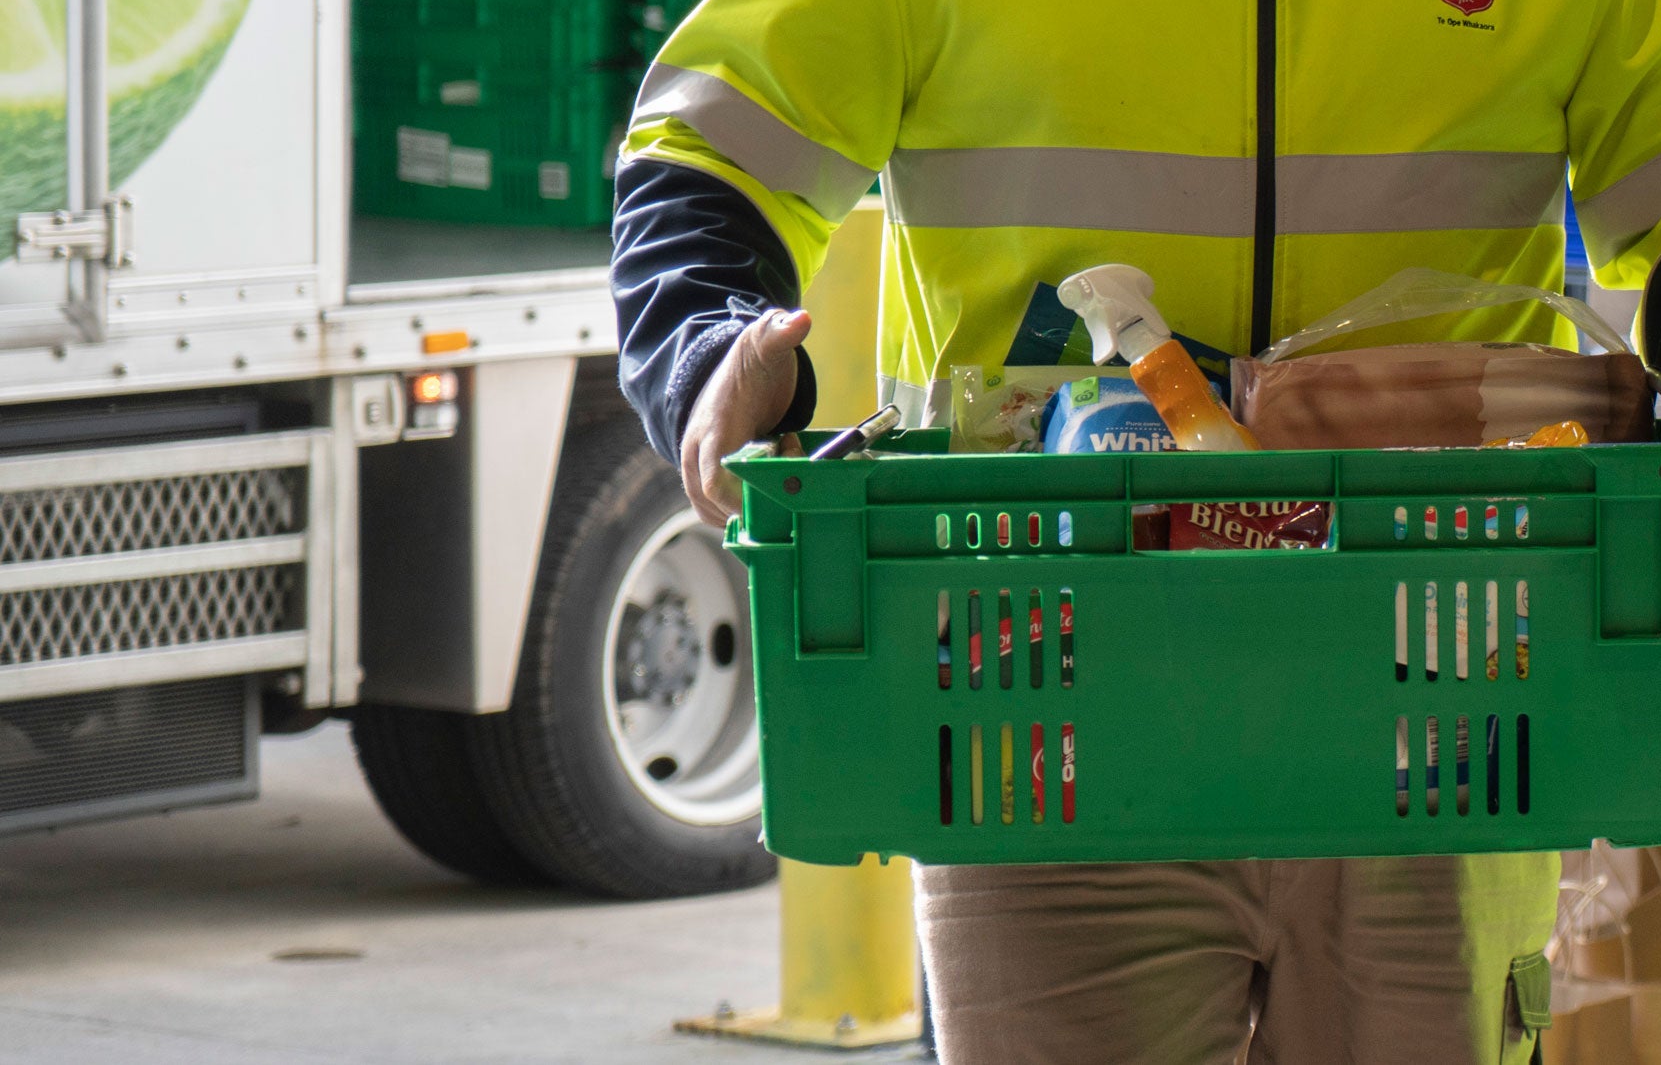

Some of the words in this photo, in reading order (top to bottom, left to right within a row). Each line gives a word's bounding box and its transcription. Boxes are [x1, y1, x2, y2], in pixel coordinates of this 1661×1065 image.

[1437, 16, 1446, 25] Te
[1089, 432, 1178, 453] Whit
[1188, 502, 1276, 550] Blen
